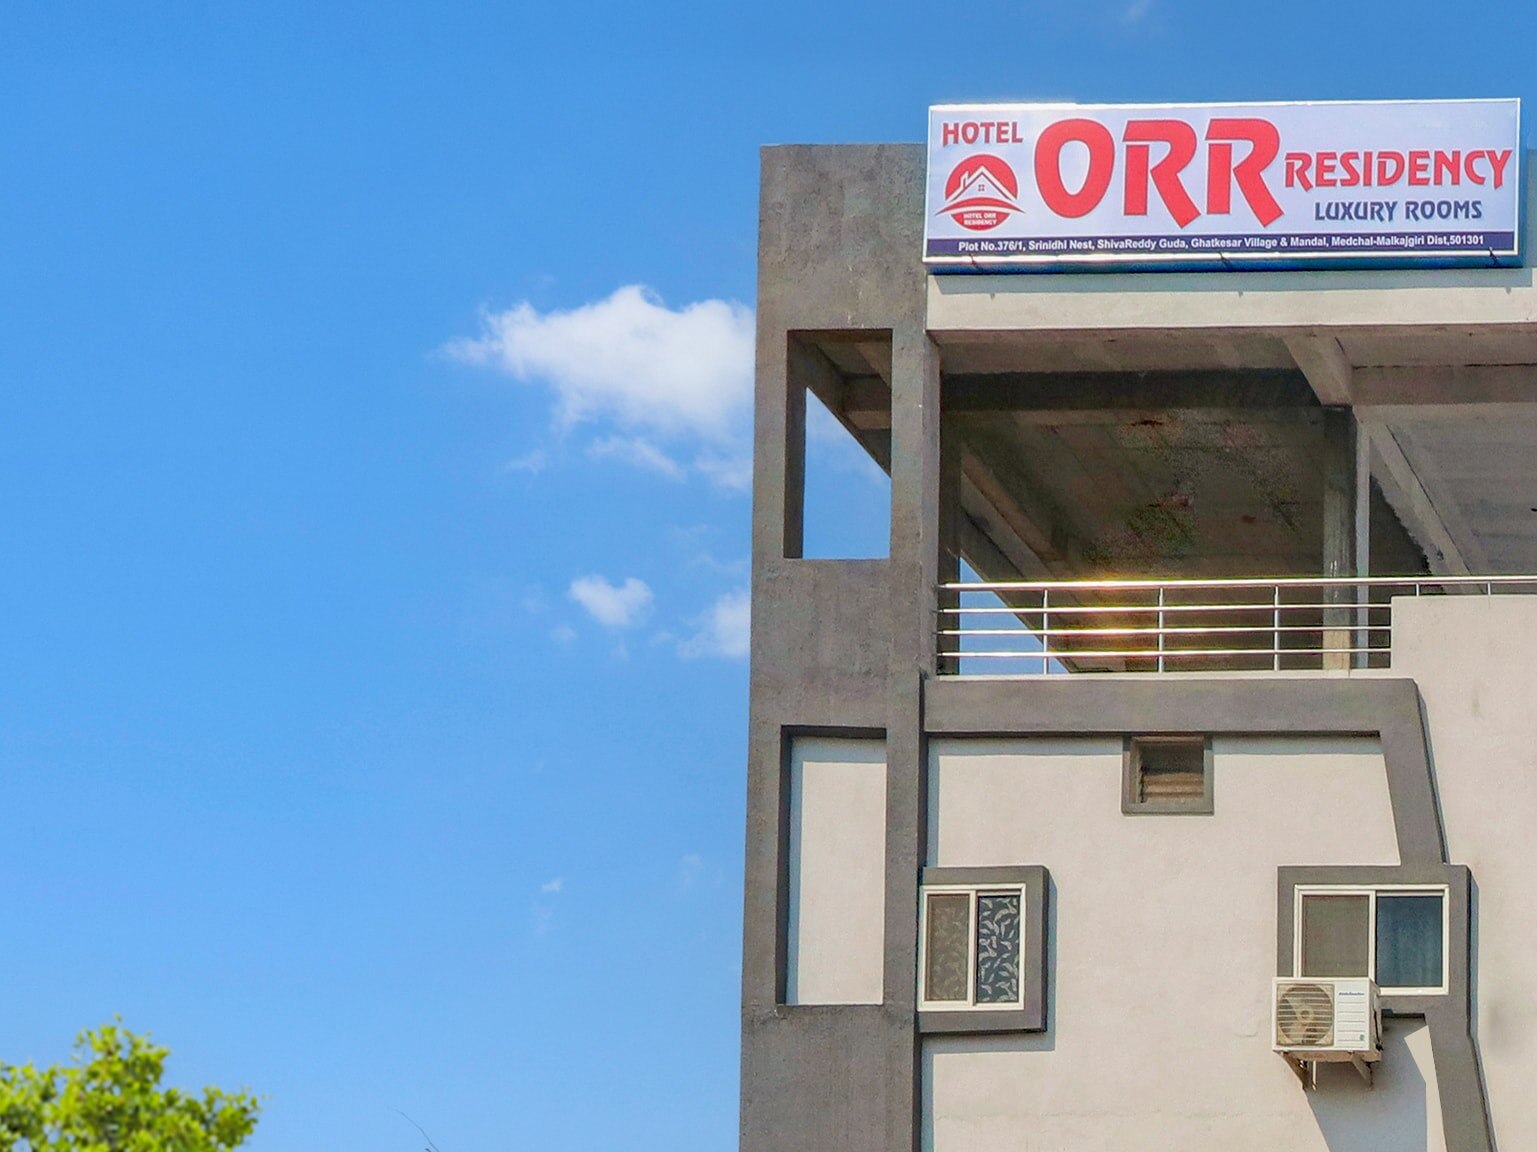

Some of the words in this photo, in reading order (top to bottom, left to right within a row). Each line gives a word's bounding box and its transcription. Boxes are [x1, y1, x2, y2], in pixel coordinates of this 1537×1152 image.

[942, 121, 1023, 145] HOTEL
[1034, 117, 1285, 229] ORR
[1284, 149, 1513, 192] RESIDENCY
[1315, 201, 1398, 222] LUXURY
[1405, 200, 1483, 221] ROOMS
[958, 241, 979, 251] Plot
[1028, 240, 1066, 251] Srinidhi
[1069, 240, 1095, 251] Nest,
[1097, 239, 1156, 250] ShivaReddy
[1158, 238, 1188, 249] Guda,
[1190, 238, 1241, 248] Ghatkesar
[1243, 237, 1278, 249] Village
[1279, 236, 1288, 247] &
[1290, 236, 1329, 247] Mandal,
